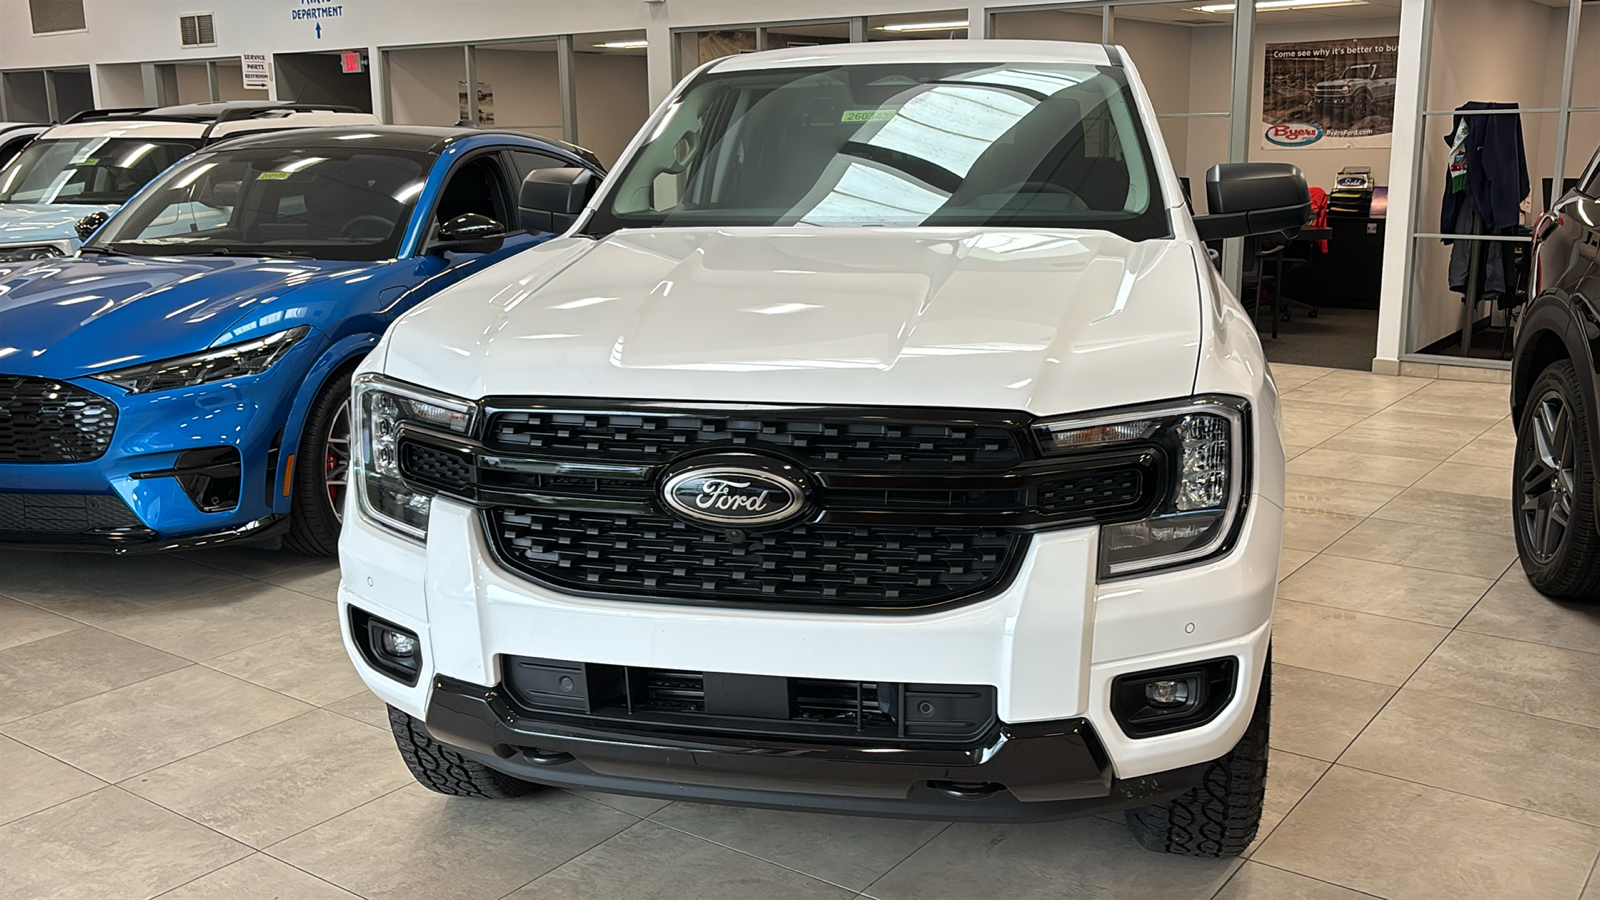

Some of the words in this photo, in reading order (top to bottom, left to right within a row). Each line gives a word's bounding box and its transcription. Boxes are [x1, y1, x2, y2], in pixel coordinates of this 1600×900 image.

[292, 6, 343, 20] DEPARTMENT
[1273, 50, 1296, 58] Come
[1313, 48, 1330, 57] why
[1332, 47, 1345, 55] it's
[1347, 45, 1372, 54] better
[1375, 45, 1384, 53] to
[1268, 124, 1317, 140] Byers
[1326, 129, 1373, 137] ByersFord.com
[695, 479, 769, 512] Ford
